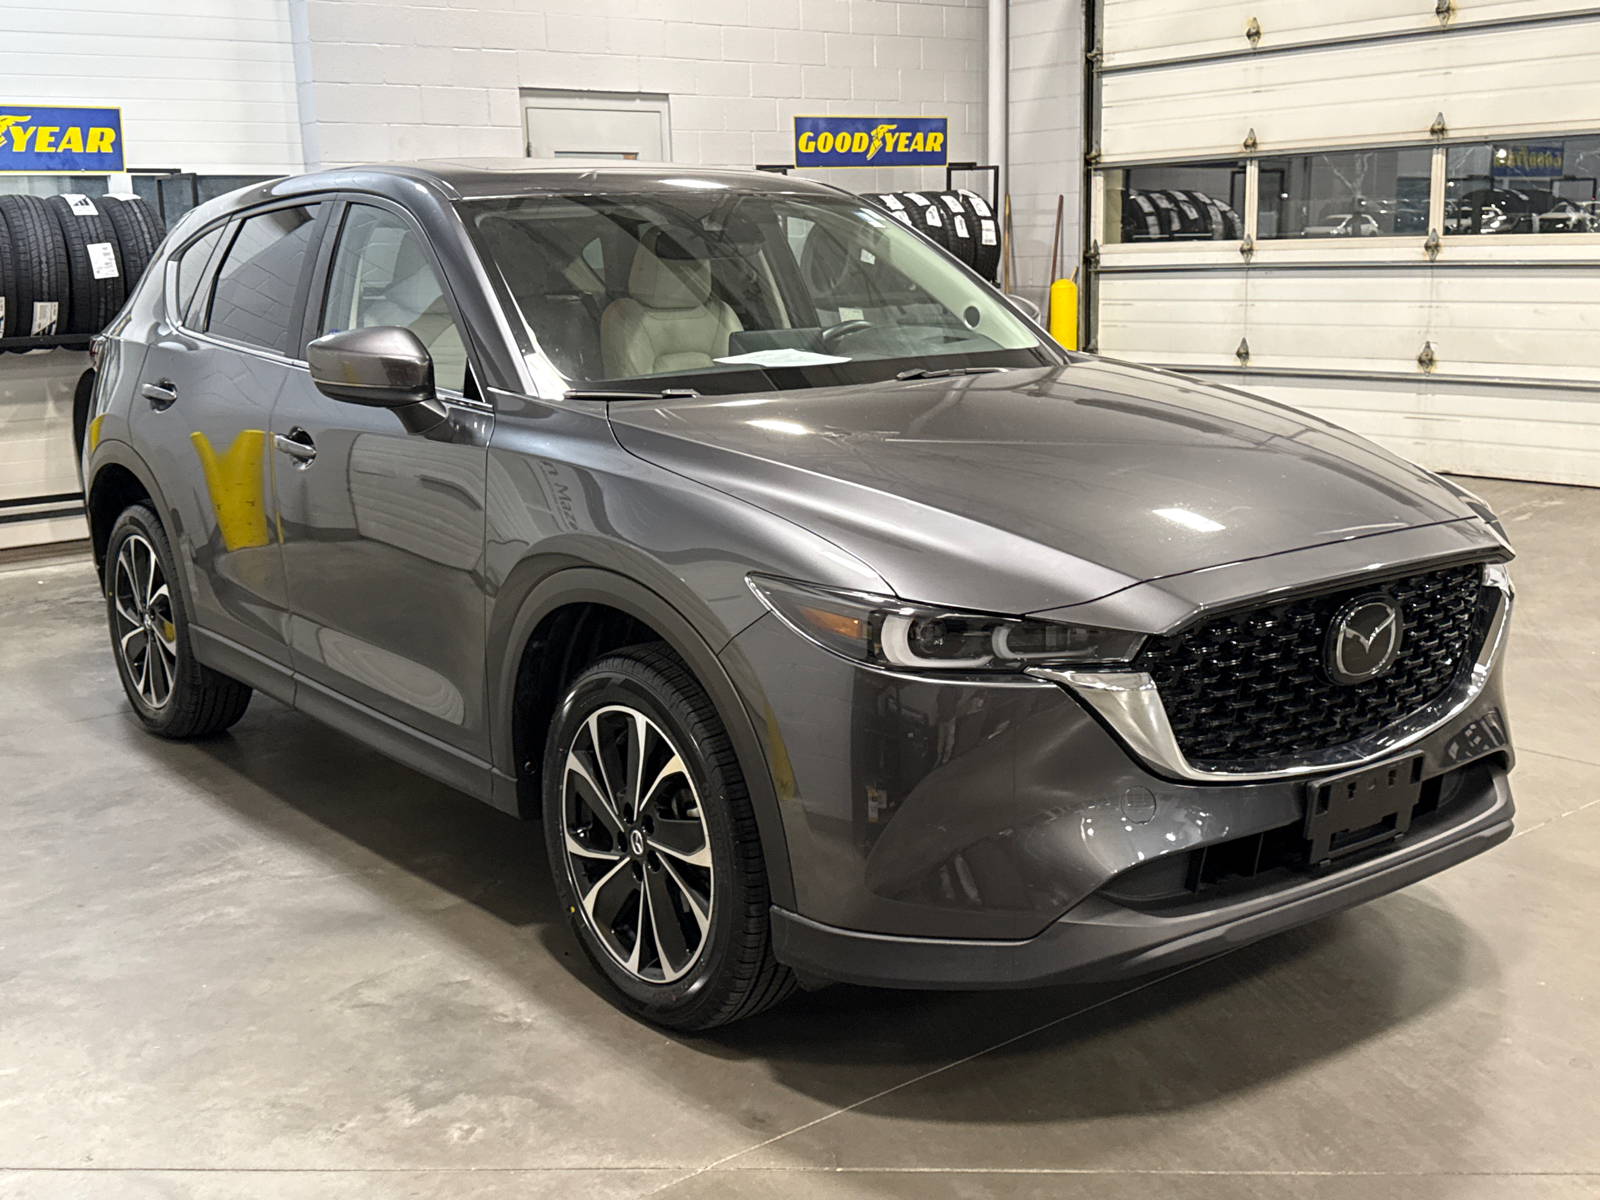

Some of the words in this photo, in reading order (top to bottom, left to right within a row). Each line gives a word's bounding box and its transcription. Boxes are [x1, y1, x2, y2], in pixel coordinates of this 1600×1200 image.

[9, 126, 116, 153] YEAR
[798, 131, 869, 153] GOOD
[884, 132, 944, 152] YEAR
